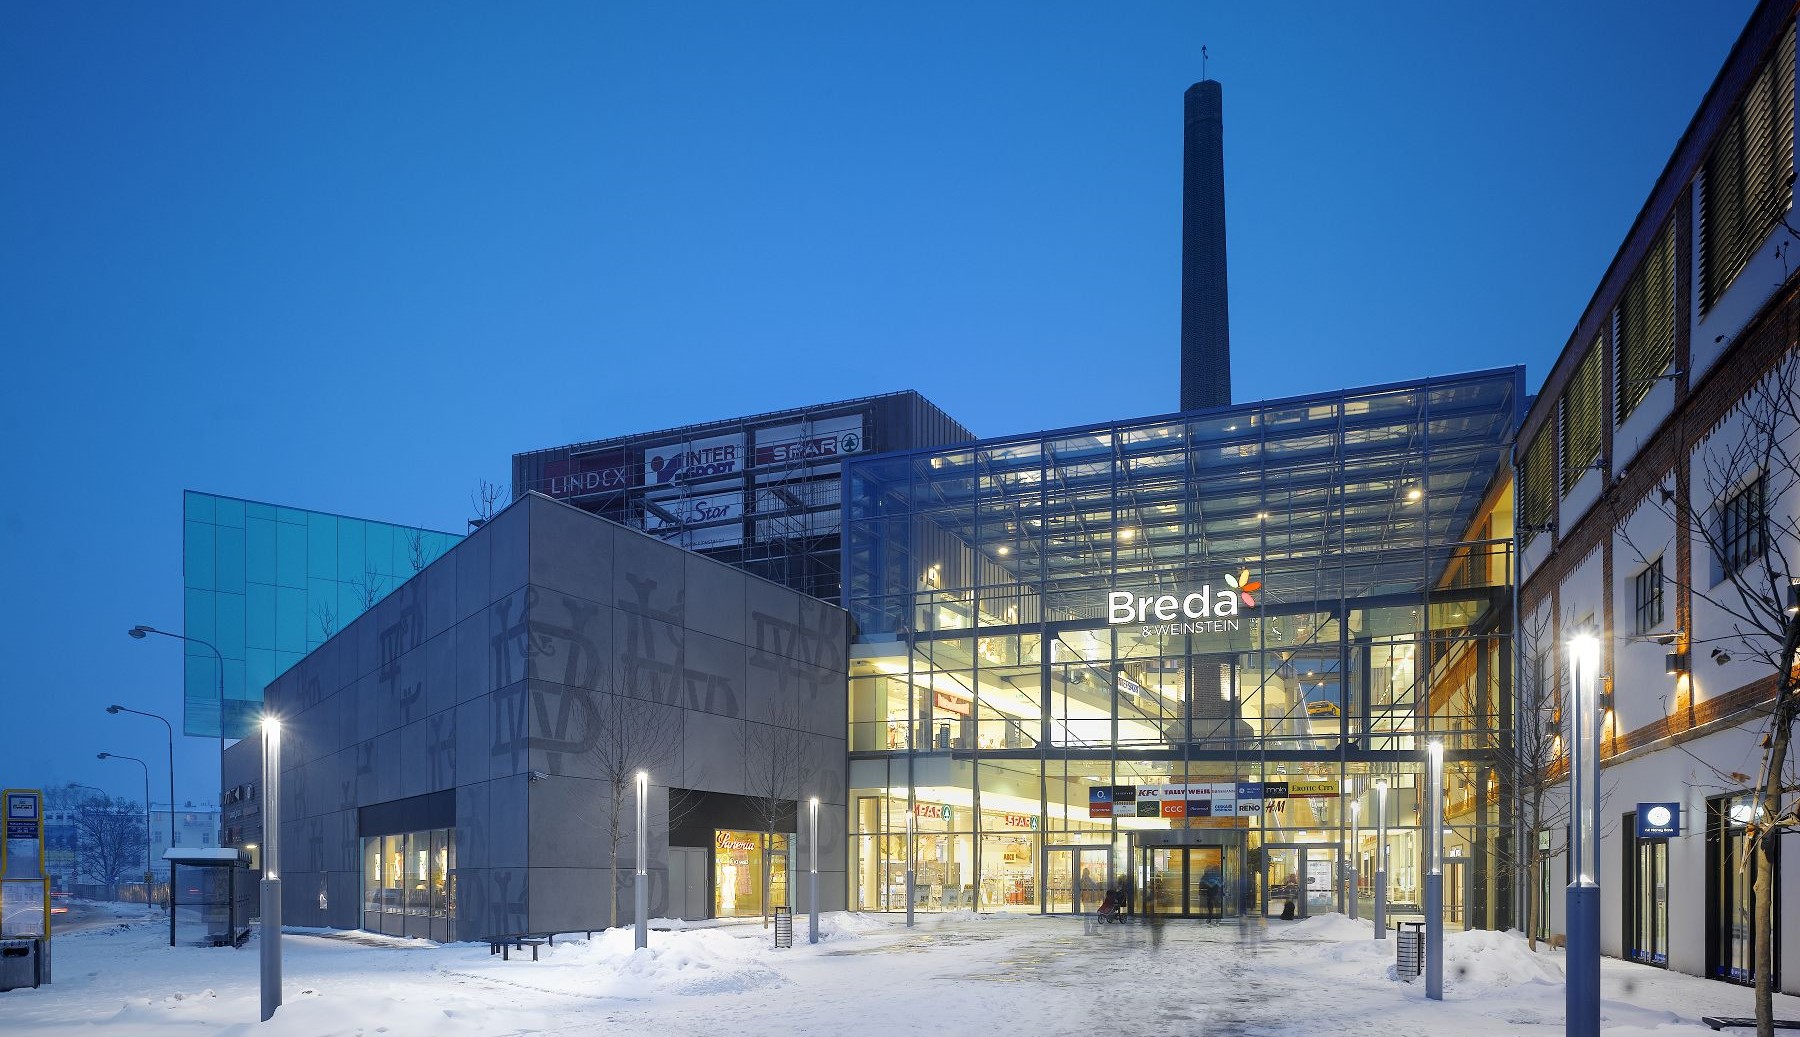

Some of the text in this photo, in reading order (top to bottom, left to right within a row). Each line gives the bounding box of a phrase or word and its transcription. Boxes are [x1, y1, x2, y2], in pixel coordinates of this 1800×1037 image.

[551, 467, 626, 494] LINDEX
[1108, 584, 1239, 625] Breda
[1142, 618, 1240, 638] & WEINSTEIN
[1138, 789, 1159, 797] KFC
[1164, 788, 1186, 796] TALLY
[1164, 805, 1183, 813] CCC
[1239, 804, 1260, 812] RENO
[716, 831, 755, 850] Paneria
